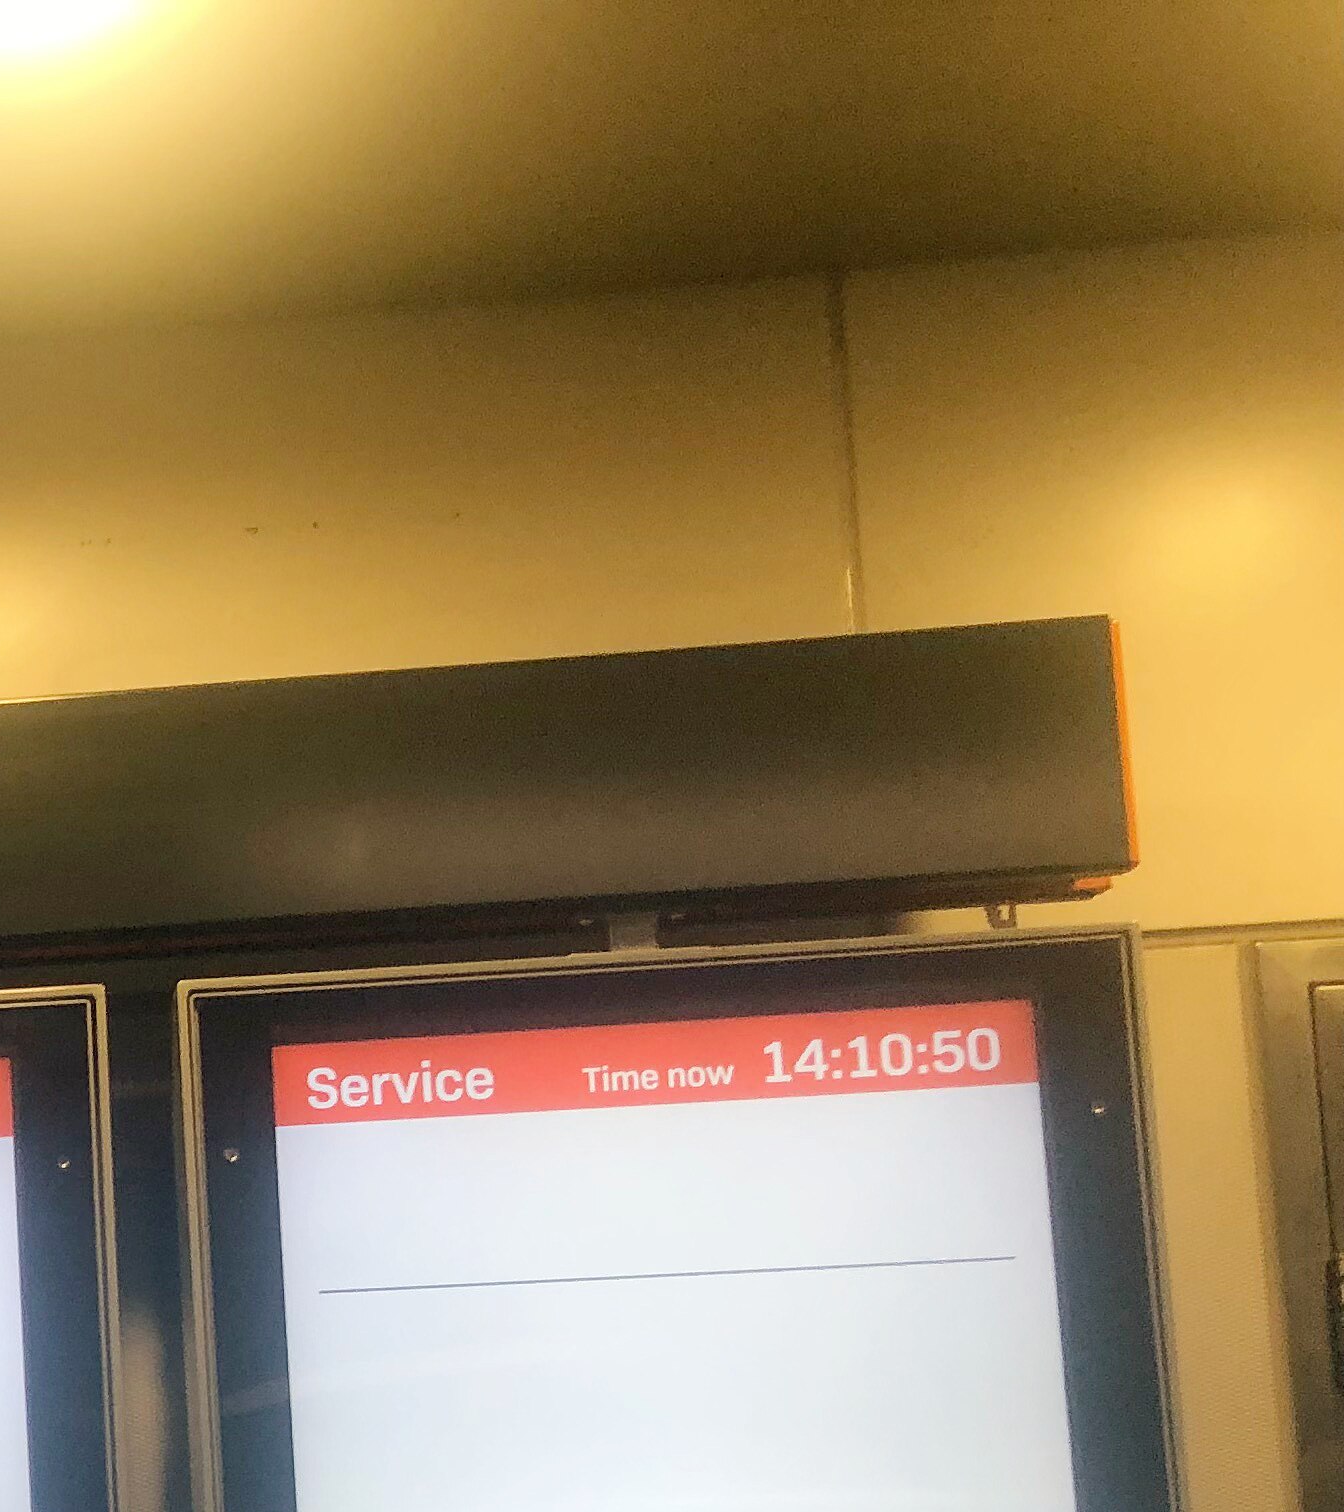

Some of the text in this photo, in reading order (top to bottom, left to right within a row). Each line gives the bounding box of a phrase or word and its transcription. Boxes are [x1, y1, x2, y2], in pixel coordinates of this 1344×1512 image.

[306, 1060, 496, 1111] Service
[582, 1027, 1003, 1093] Time now 14:10:50
